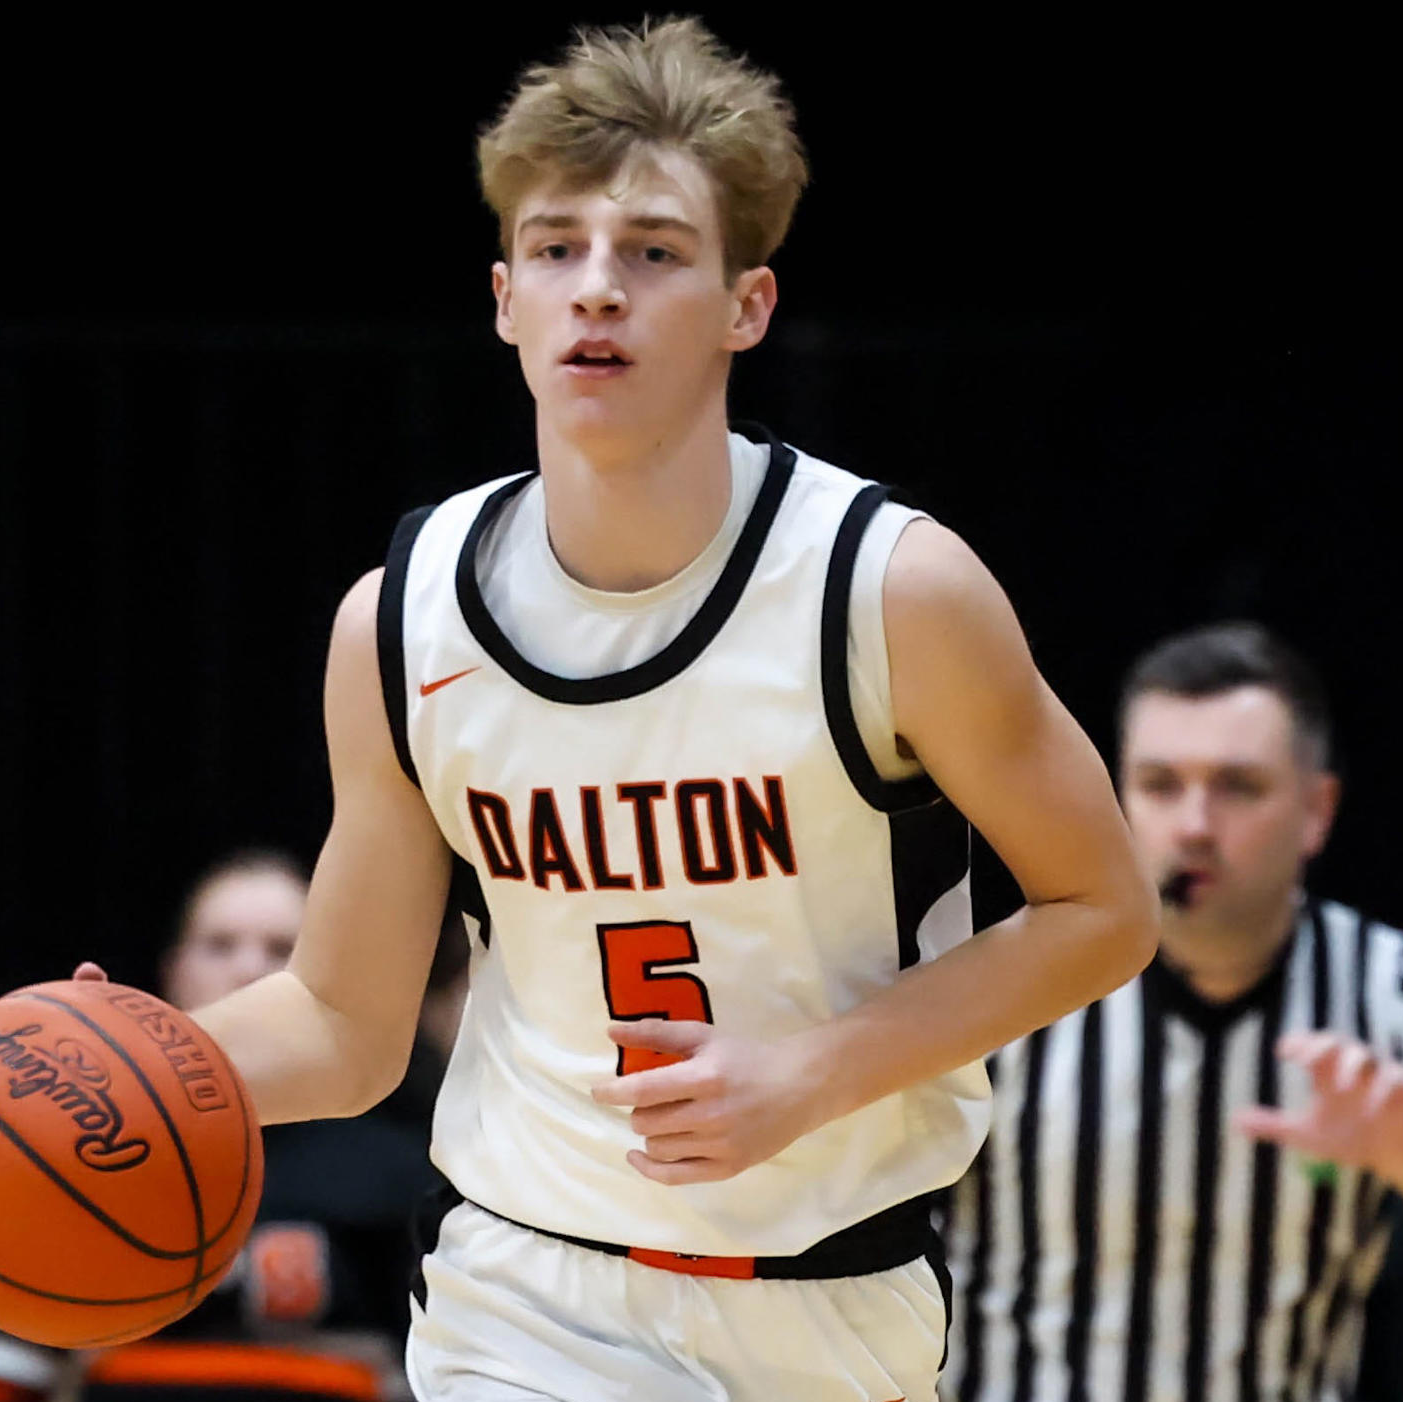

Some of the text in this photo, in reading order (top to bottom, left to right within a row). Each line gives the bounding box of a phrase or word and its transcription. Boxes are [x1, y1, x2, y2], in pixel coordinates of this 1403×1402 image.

[466, 775, 798, 893] DALTON
[88, 985, 230, 1112] OHSA
[596, 919, 714, 1077] 5
